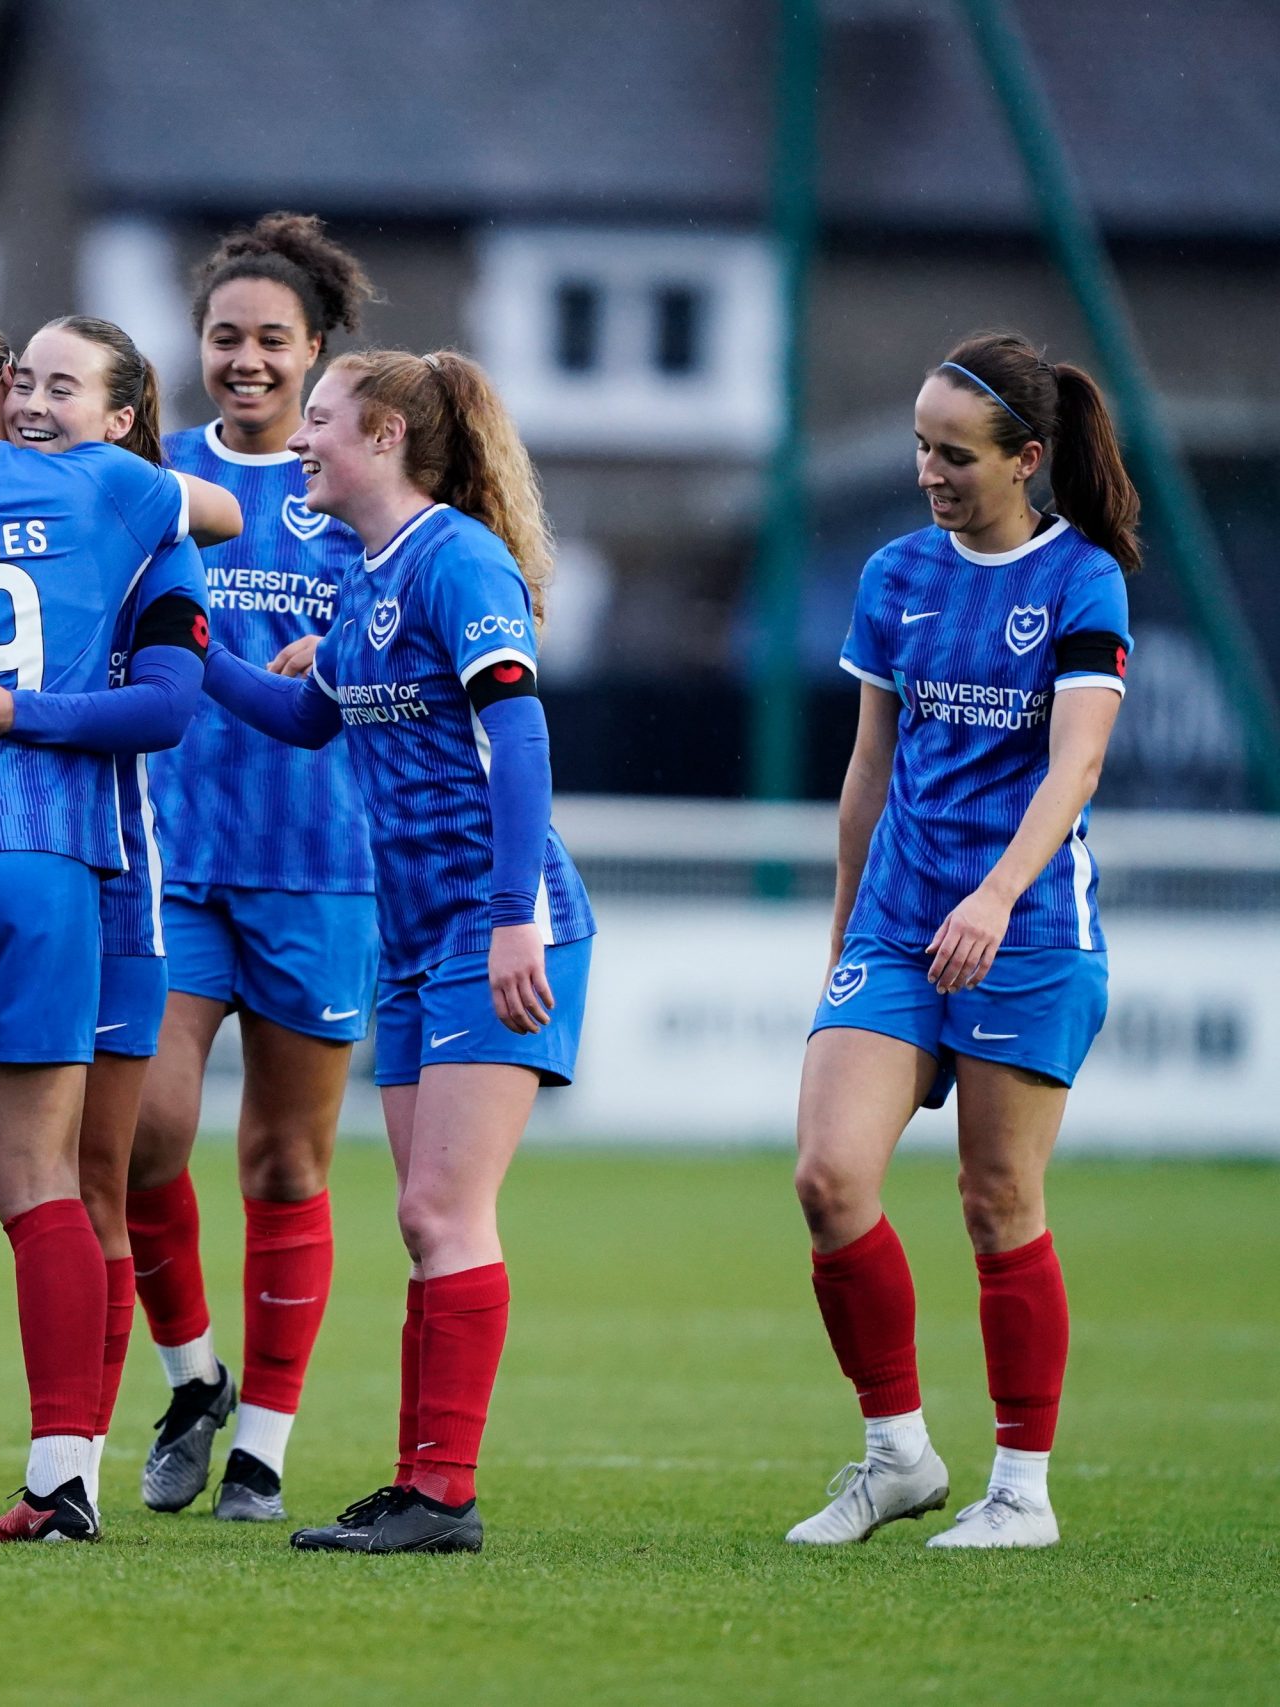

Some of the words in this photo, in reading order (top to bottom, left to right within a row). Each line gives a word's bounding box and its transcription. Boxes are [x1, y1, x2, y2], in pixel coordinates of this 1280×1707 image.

[206, 568, 319, 595] IVERSITY
[315, 582, 338, 598] OF
[210, 589, 333, 620] RTSMOUTH
[465, 615, 525, 641] ecco
[336, 682, 397, 704] NIVERSITY
[399, 683, 420, 700] OF
[916, 680, 1033, 709] UNIVERSITY
[1032, 690, 1049, 707] OF
[340, 700, 430, 725] ORTSMOUTH
[920, 702, 1047, 730] PORTSMOUTH
